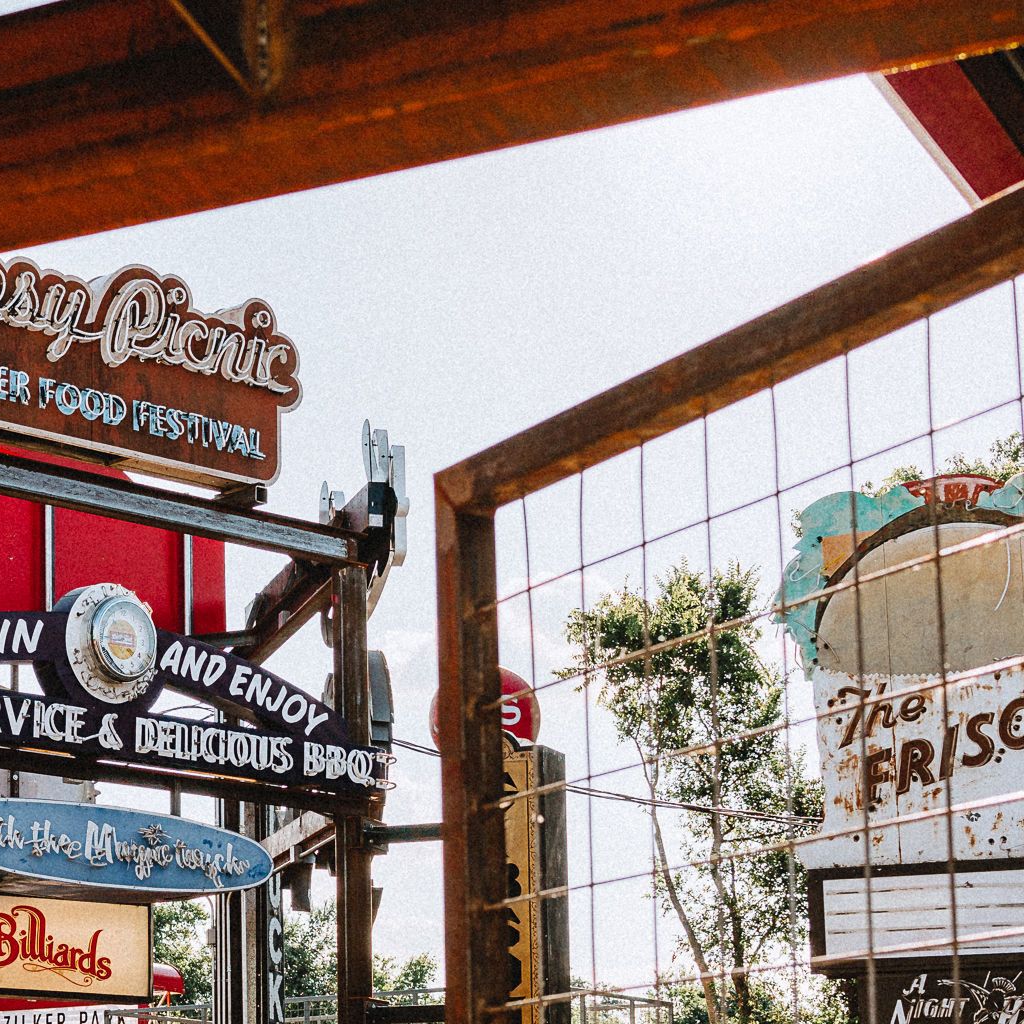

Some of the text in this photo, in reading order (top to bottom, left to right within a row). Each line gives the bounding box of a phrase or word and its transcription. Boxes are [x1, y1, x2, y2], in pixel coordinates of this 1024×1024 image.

[103, 275, 294, 393] Picnic
[38, 377, 127, 426] FOOD
[132, 399, 267, 461] FESTIVAL
[159, 640, 226, 688] AND
[229, 664, 329, 737] ENJOY
[837, 683, 927, 750] The
[98, 712, 124, 751] &
[135, 716, 294, 775] DELICIOUS
[303, 742, 376, 788] BBQ
[25, 818, 83, 860] the
[902, 973, 928, 997] A
